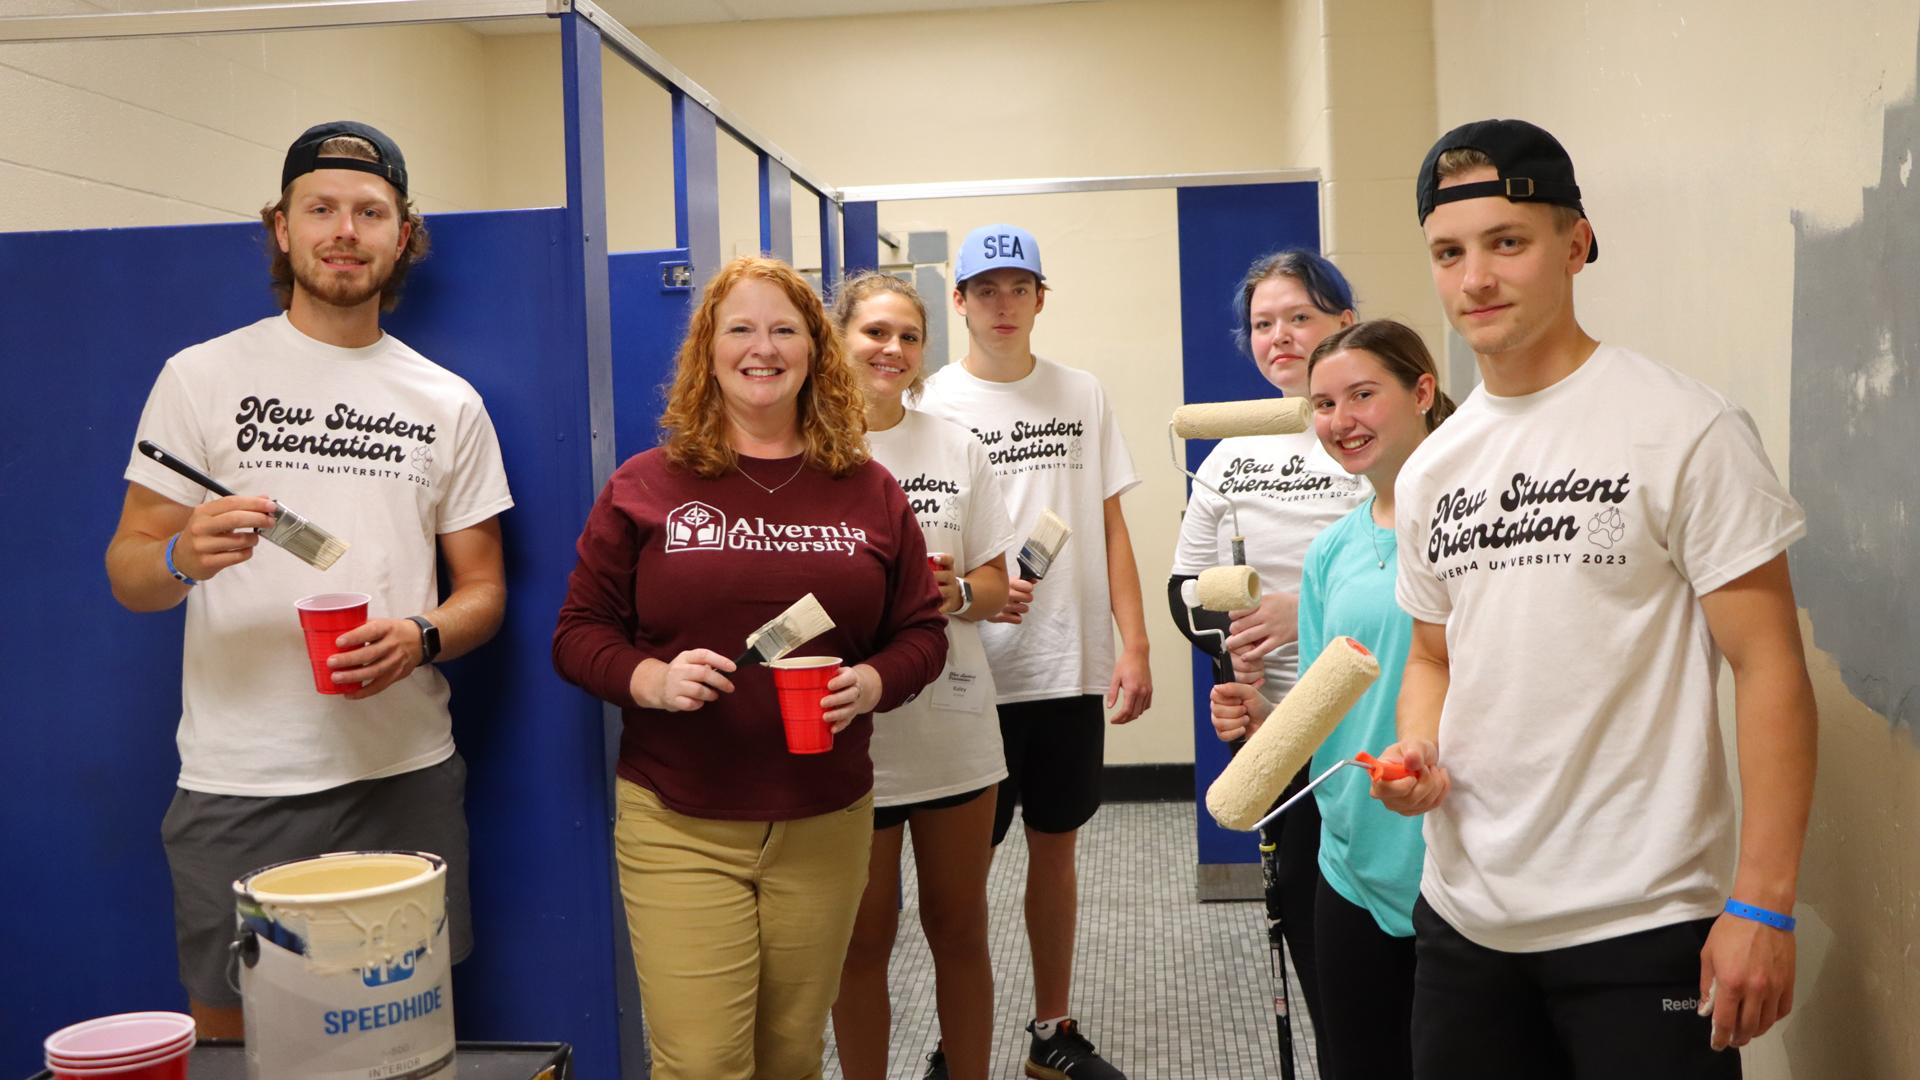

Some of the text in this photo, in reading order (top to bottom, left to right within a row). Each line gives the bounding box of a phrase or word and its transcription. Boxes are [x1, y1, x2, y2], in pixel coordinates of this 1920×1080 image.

[983, 234, 1025, 260] SEA
[235, 396, 437, 445] New Student
[1011, 417, 1084, 443] Student
[236, 423, 406, 464] Orientation
[988, 439, 1067, 465] entation
[238, 460, 310, 471] ALVERNIA
[317, 464, 401, 480] UNIVERSITY
[1011, 462, 1066, 475] UNIVERSITY
[1223, 457, 1274, 478] New
[898, 473, 959, 495] udent
[1218, 473, 1333, 495] Orientation
[1431, 468, 1630, 530] New Student
[728, 517, 869, 545] Alvernia
[1428, 507, 1580, 564] Orientation
[729, 534, 856, 557] University
[1582, 553, 1627, 565] 2023
[323, 986, 442, 1036] SPEEDHIDE
[1661, 997, 1700, 1012] Reeb
[368, 1057, 422, 1079] INTERIOR
